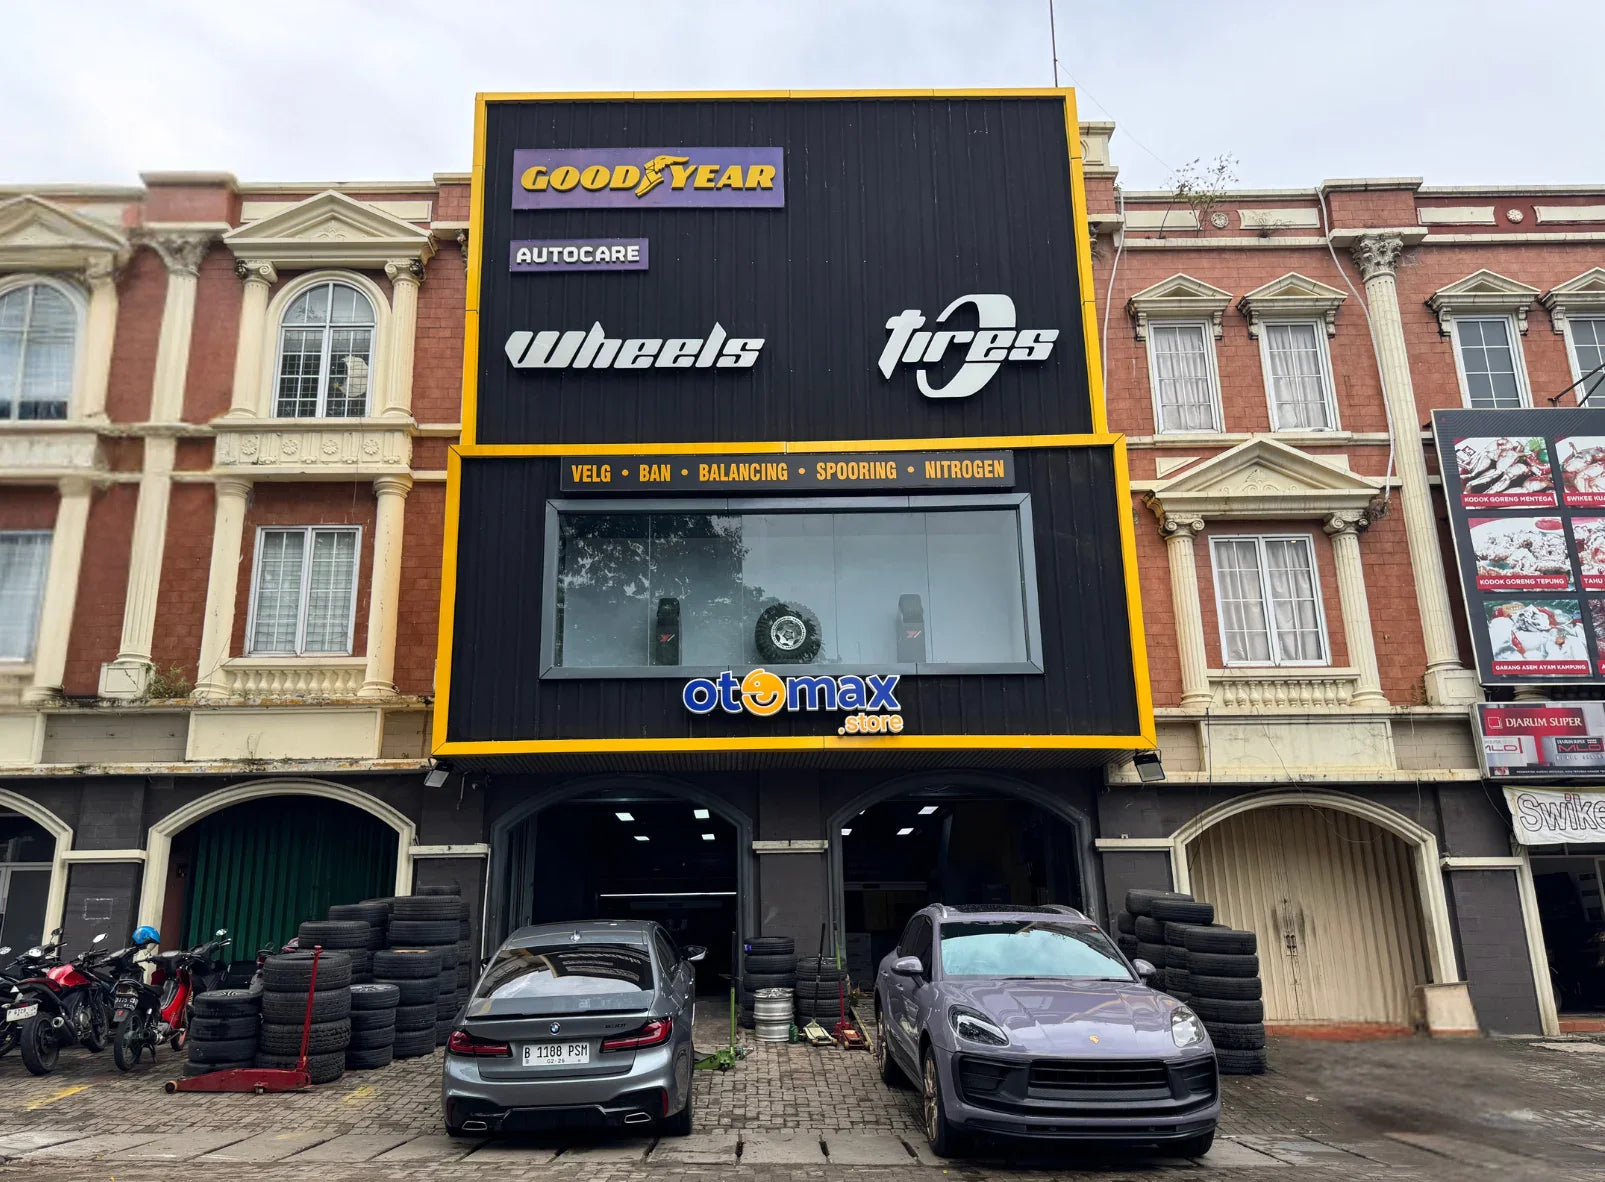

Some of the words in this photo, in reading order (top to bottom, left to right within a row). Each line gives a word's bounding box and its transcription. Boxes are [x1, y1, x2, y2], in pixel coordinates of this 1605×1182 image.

[516, 245, 640, 264] AUTOCARE
[878, 308, 1060, 381] tires
[571, 464, 612, 483] VELG
[639, 463, 671, 482] BAN
[699, 462, 788, 481] BALANCING
[816, 461, 897, 481] SPOORING
[925, 459, 1005, 479] NITROGEN
[683, 668, 902, 716] otomax
[1505, 717, 1547, 728] DJARUM
[1549, 717, 1583, 727] SUPER
[524, 1047, 531, 1059] B
[537, 1045, 562, 1058] 1188
[568, 1044, 588, 1057] PSM
